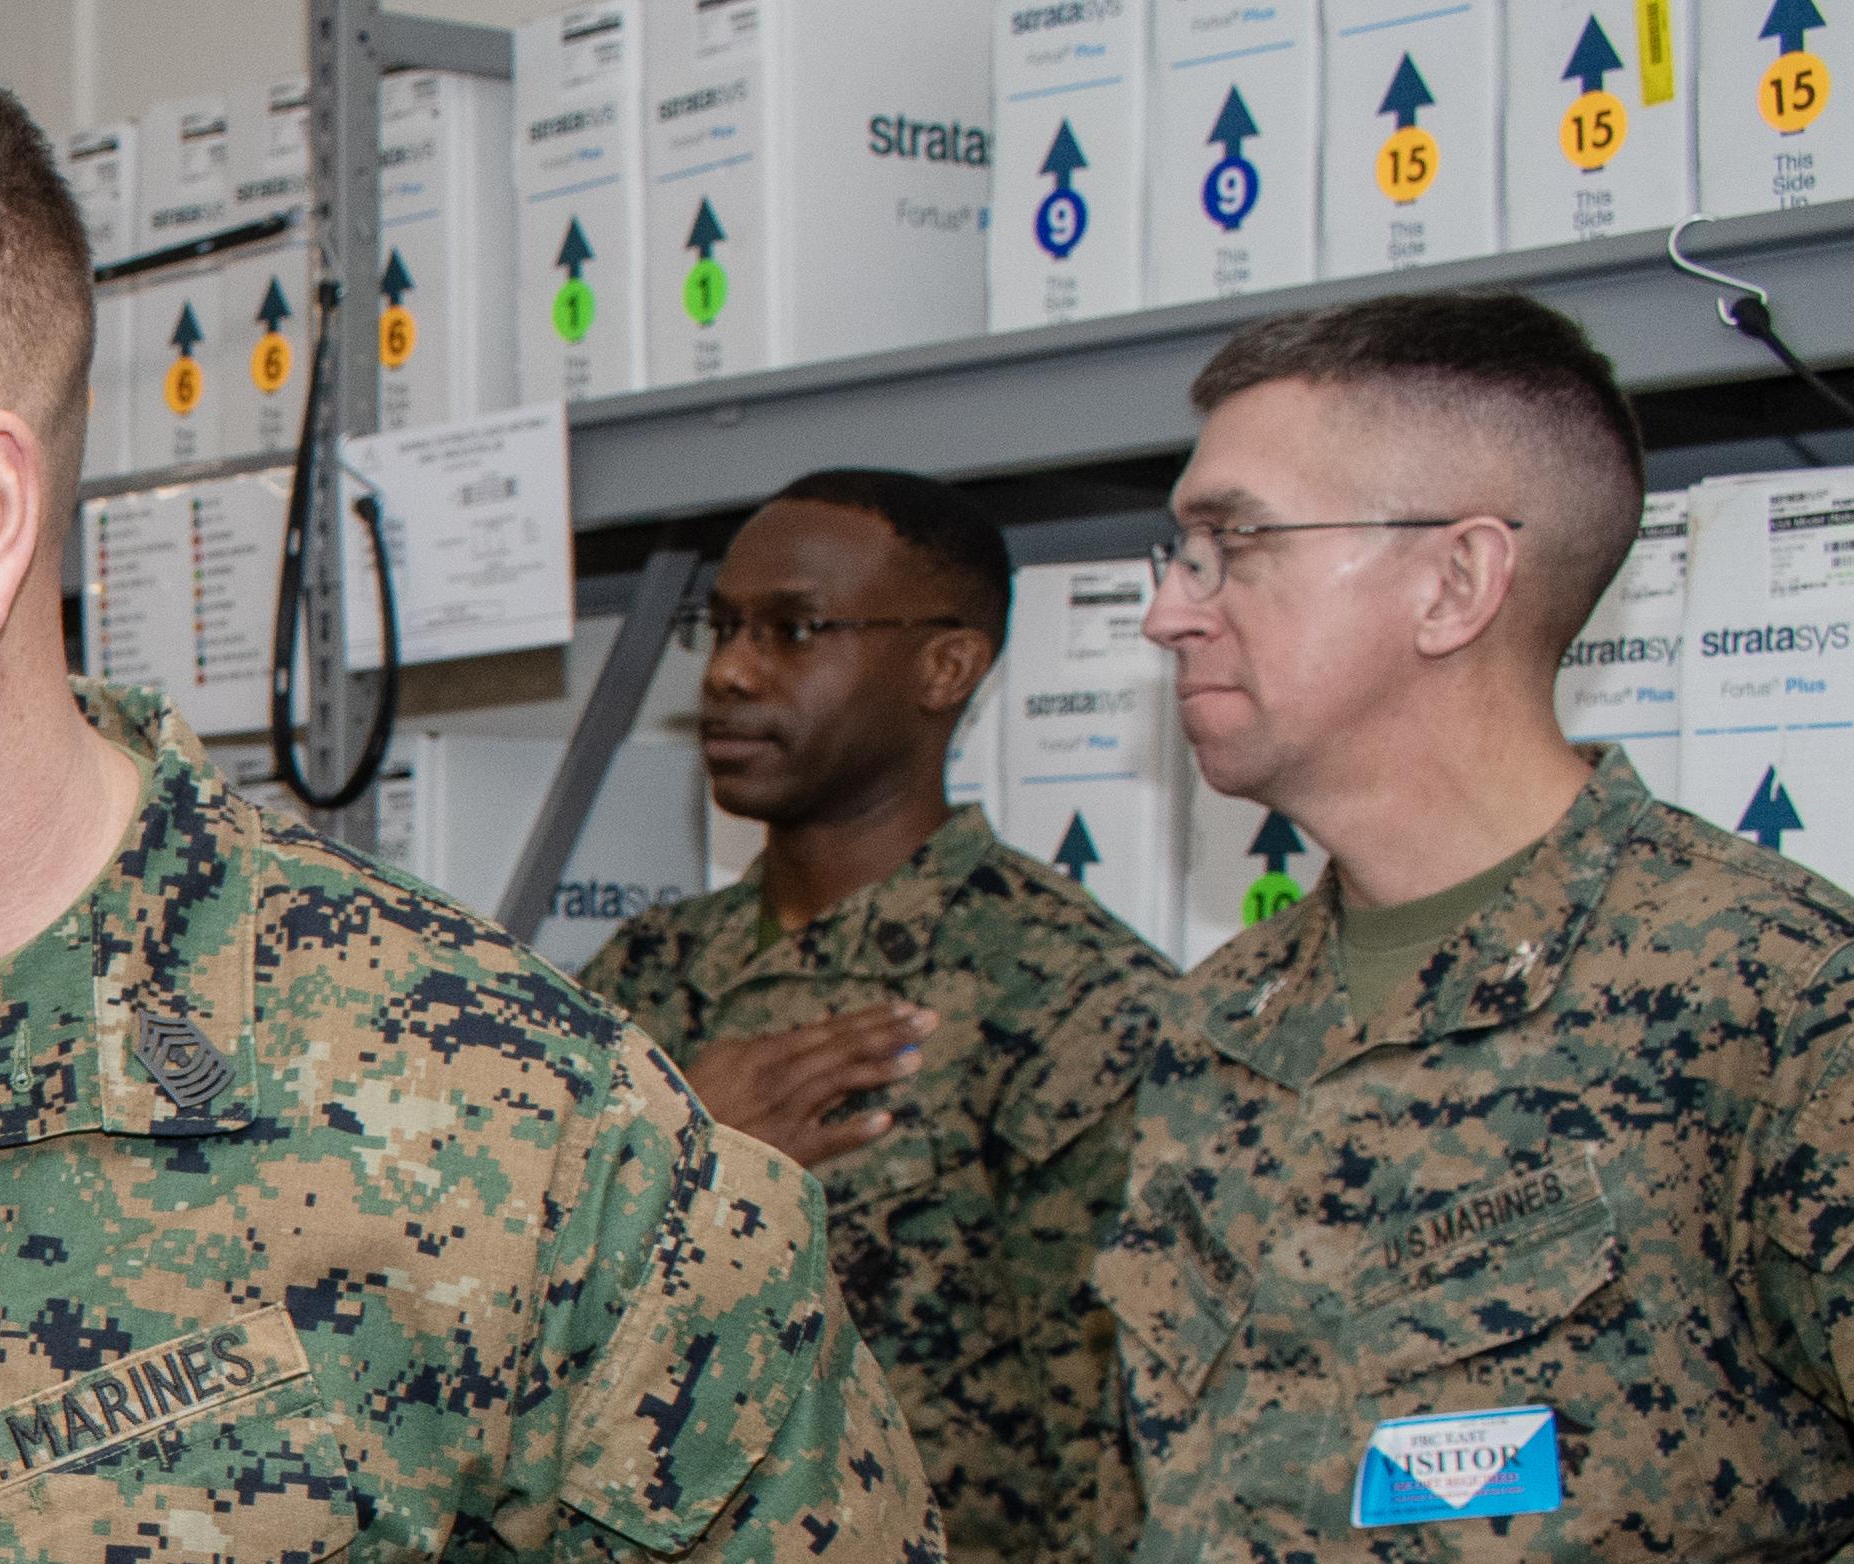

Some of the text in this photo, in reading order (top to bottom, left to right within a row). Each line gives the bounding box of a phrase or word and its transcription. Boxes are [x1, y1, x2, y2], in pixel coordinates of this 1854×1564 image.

[1769, 69, 1817, 116] 15
[867, 112, 991, 168] strata
[1572, 109, 1614, 152] 15
[1388, 145, 1428, 185] 15
[1773, 152, 1814, 173] This
[1217, 165, 1247, 216] 9
[1772, 173, 1816, 195] Side
[1047, 197, 1078, 247] 9
[694, 270, 714, 307] 1
[564, 292, 581, 329] 1
[386, 317, 406, 353] 6
[262, 343, 283, 380] 6
[175, 366, 195, 401] 6
[1560, 633, 1684, 669] stratasy
[1701, 621, 1851, 659] stratasys
[1786, 675, 1827, 694] Plus
[1428, 1173, 1563, 1244] MARINES
[4, 1329, 255, 1474] MARINES
[1382, 1443, 1523, 1478] VISITOR
